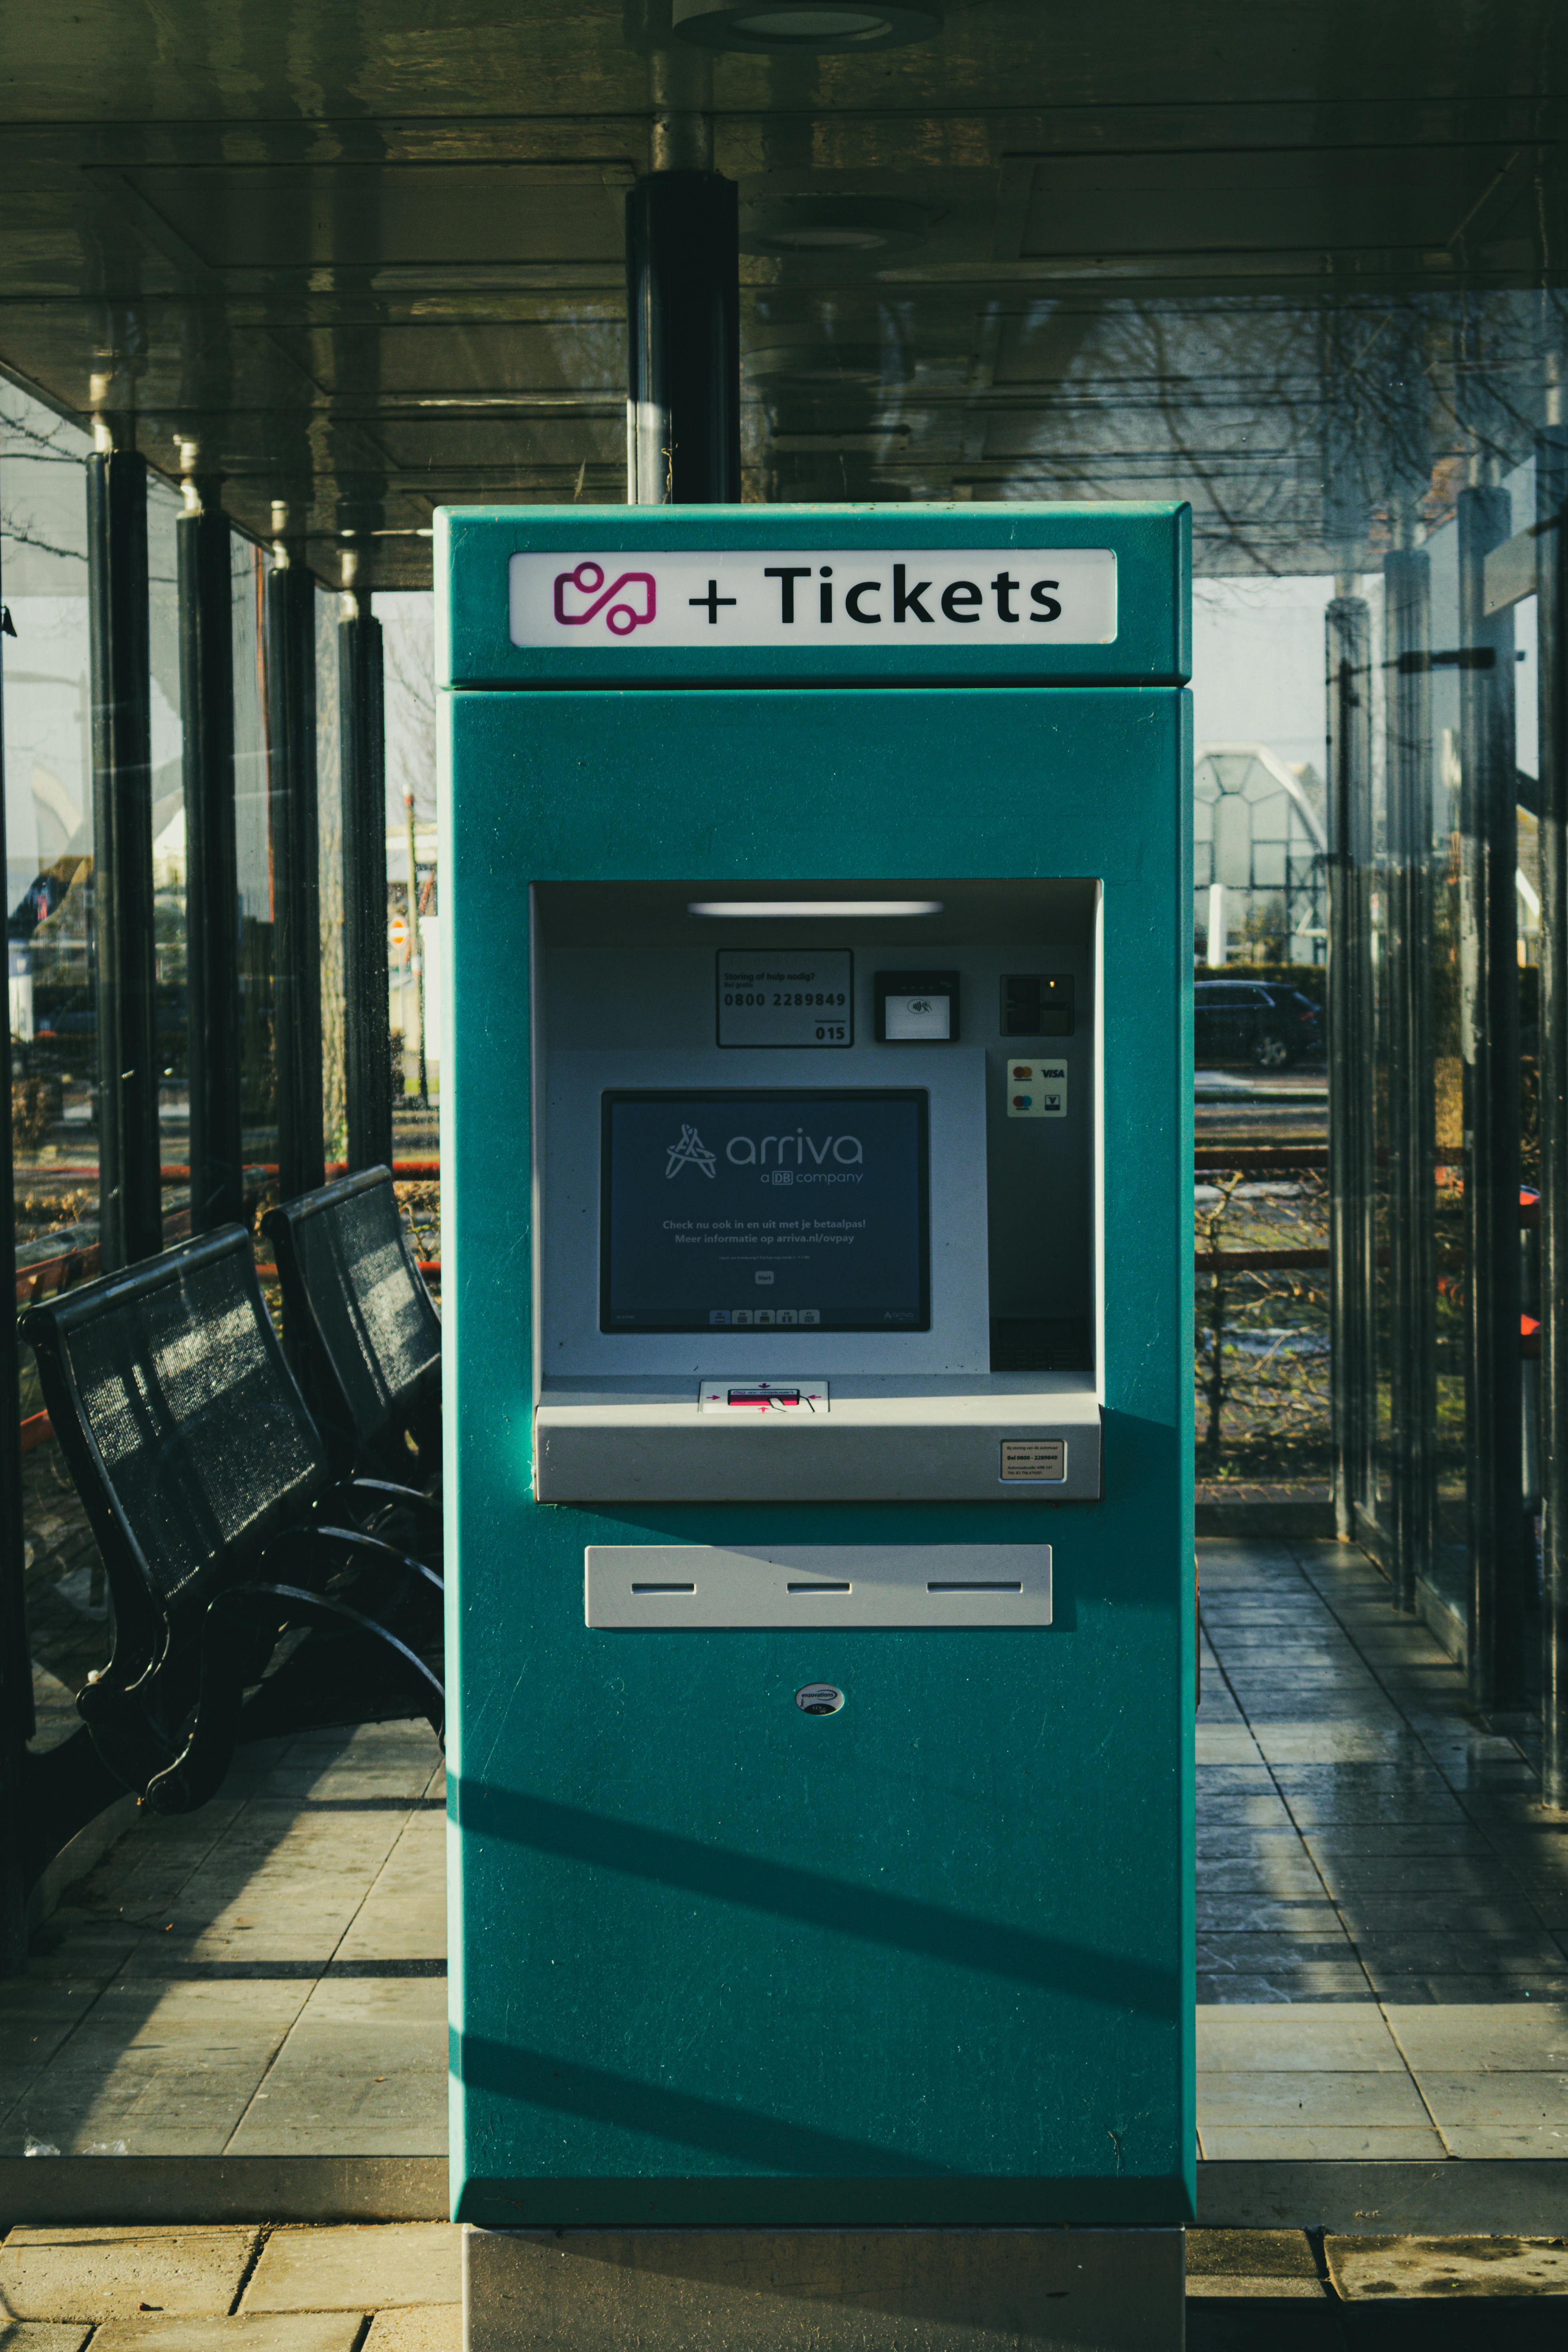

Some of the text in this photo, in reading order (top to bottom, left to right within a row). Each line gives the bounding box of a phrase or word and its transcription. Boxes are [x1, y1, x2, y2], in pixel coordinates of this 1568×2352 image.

[764, 563, 1062, 623] Tickets
[724, 972, 815, 982] Storing of hulp nodig?
[724, 993, 845, 1006] 0800 2289849
[815, 1027, 845, 1040] 015
[1041, 1069, 1065, 1078] VISA
[726, 1127, 863, 1165] arriva
[760, 1172, 863, 1185] a DB company
[663, 1220, 693, 1229] Check
[712, 1220, 732, 1229] ook
[735, 1220, 744, 1229] in
[762, 1220, 777, 1229] uit
[779, 1220, 799, 1229] met
[801, 1220, 811, 1230] je
[813, 1219, 866, 1230] betaalpas!
[675, 1233, 855, 1245] Meer informatie op arriva.nl/ovpay
